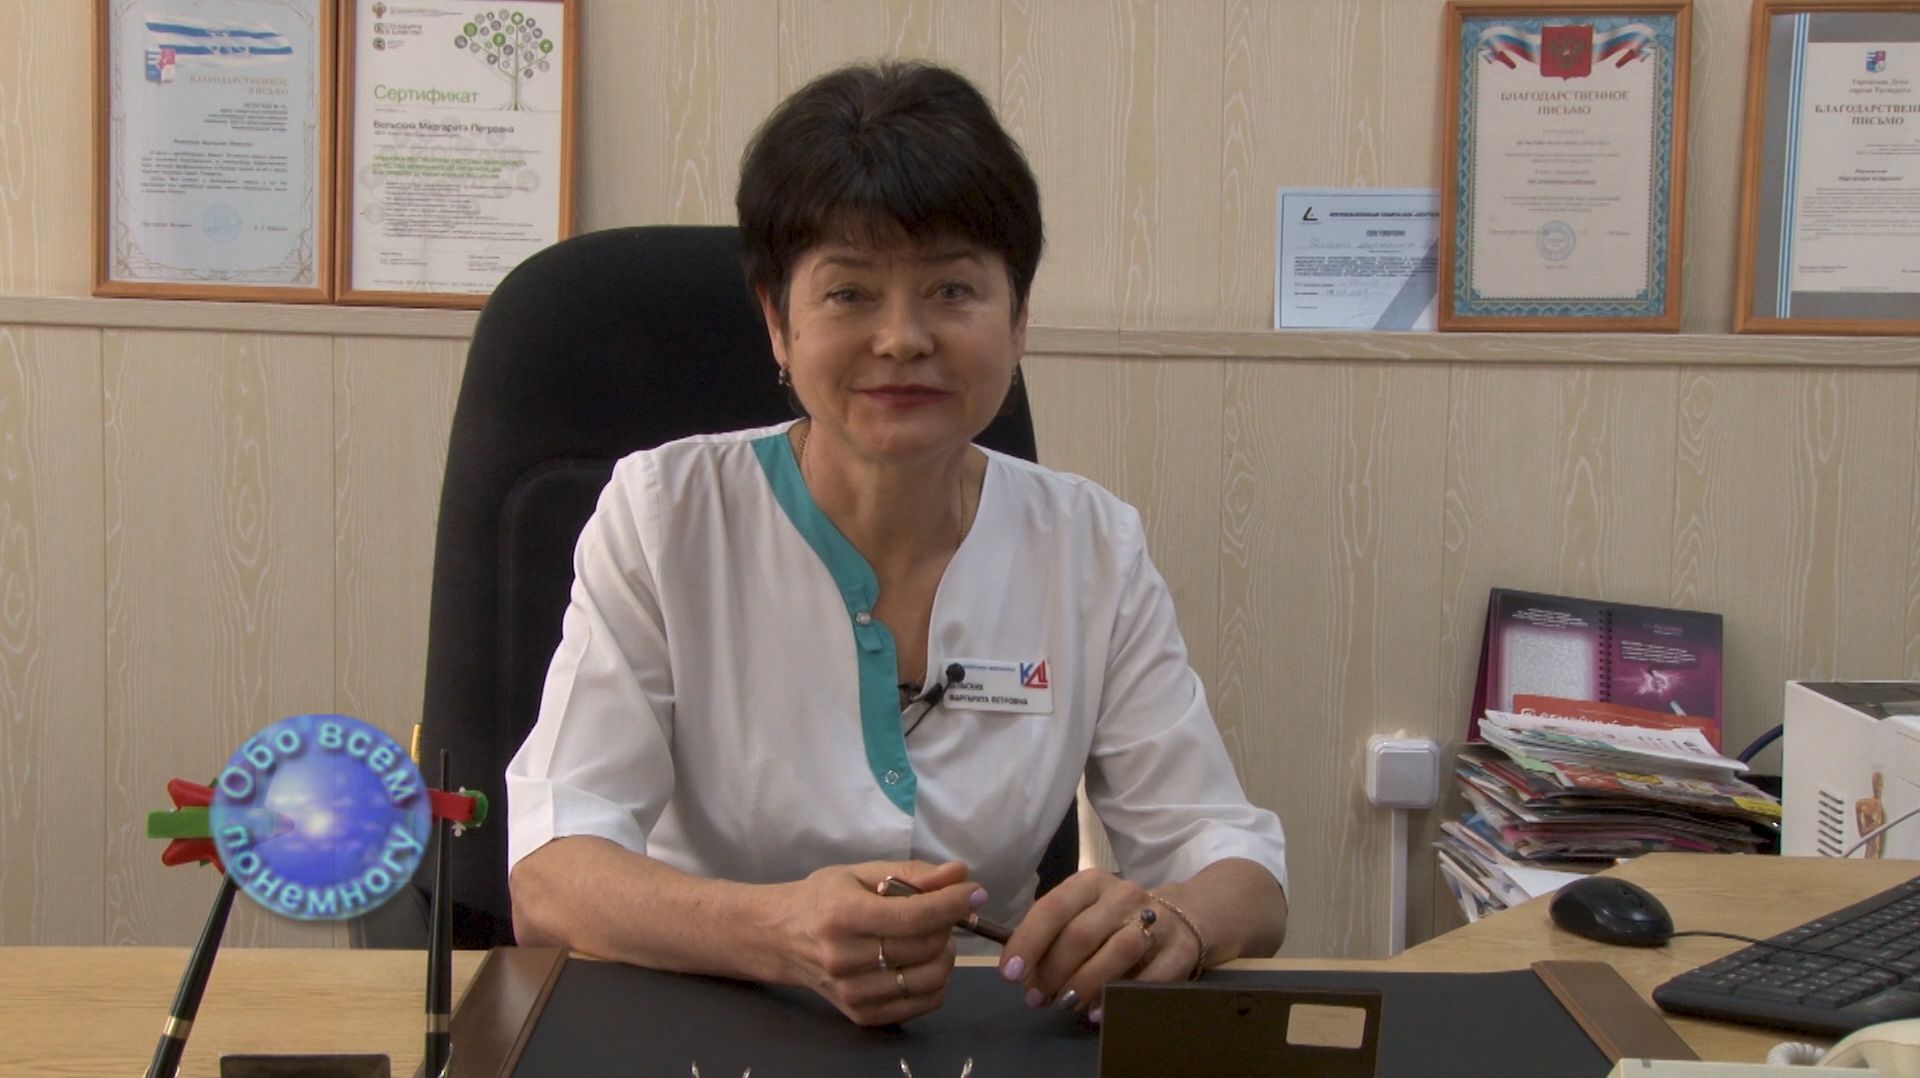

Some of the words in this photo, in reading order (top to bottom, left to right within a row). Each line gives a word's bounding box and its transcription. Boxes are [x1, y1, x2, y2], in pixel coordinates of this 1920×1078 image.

[373, 84, 479, 105] Сертификат
[1500, 90, 1629, 102] БЛАГОДАРСТВЕННОЕ
[1537, 106, 1592, 115] ПИСЬМО
[1851, 116, 1905, 126] ПИСЬМО
